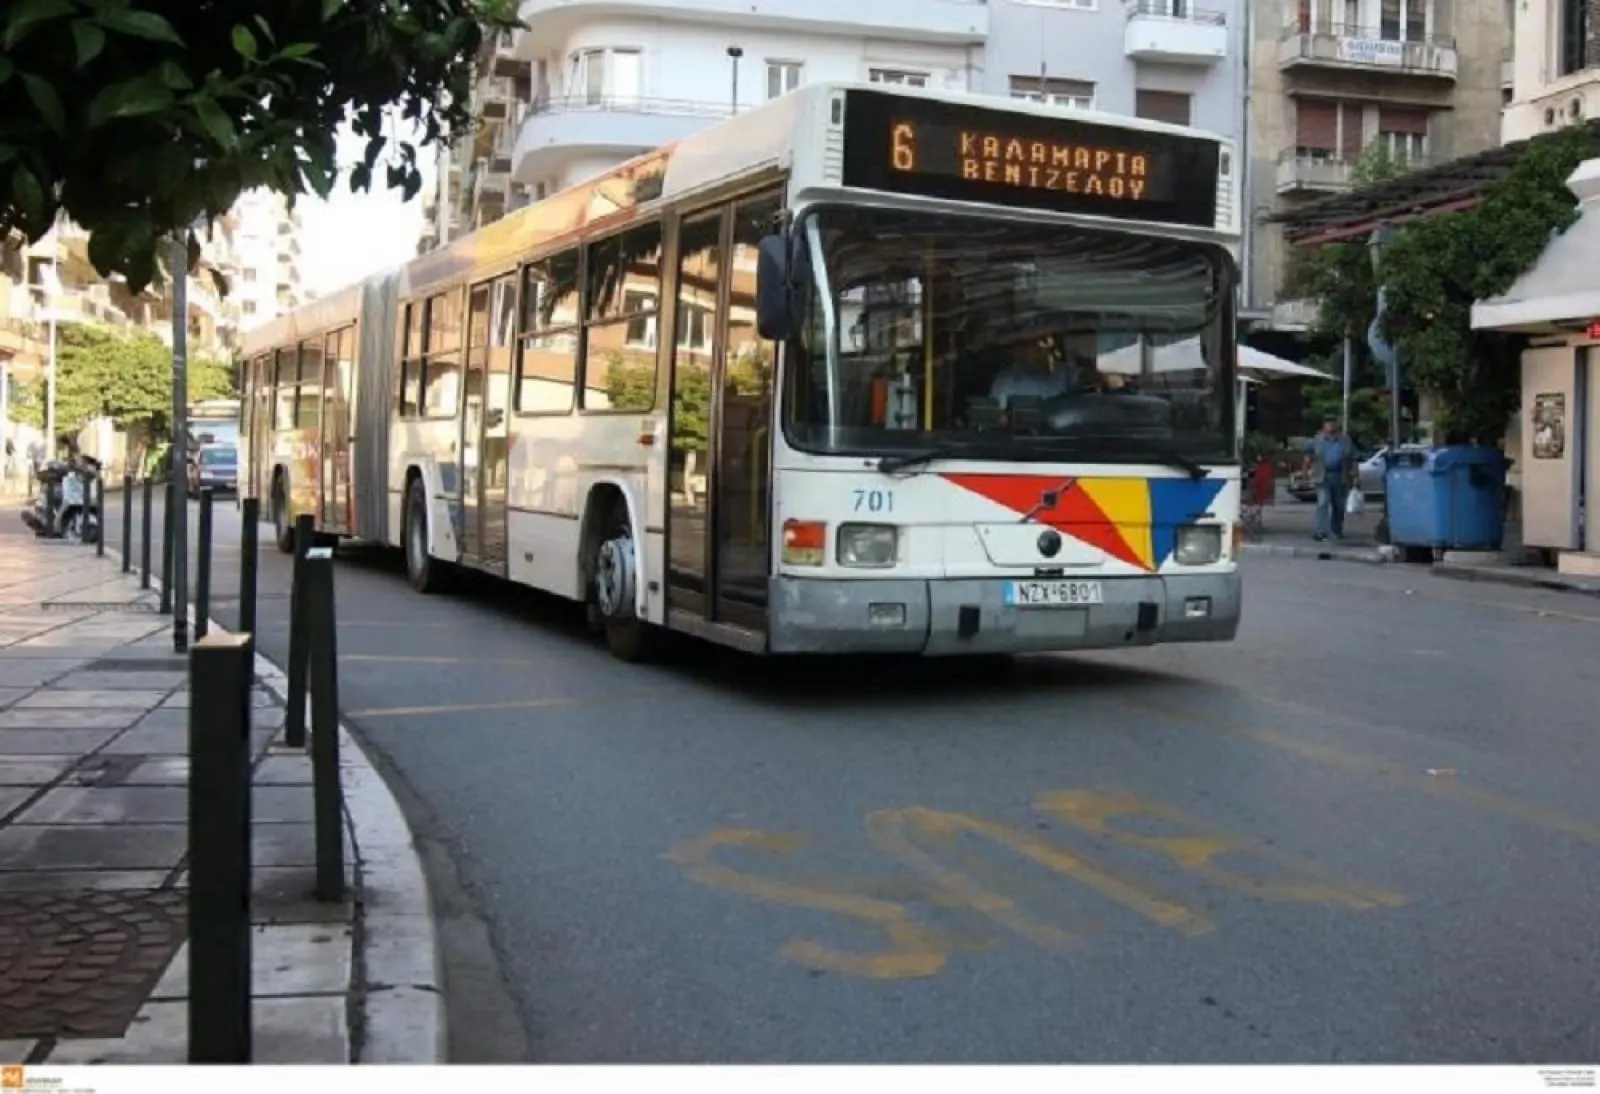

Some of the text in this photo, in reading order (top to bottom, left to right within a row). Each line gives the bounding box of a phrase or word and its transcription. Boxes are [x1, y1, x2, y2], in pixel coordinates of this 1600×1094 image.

[891, 123, 1147, 176] 6 ΚΑΛΑΜΑΡΙΑ
[962, 159, 1146, 199] ΒΕΝΙΖΕΛΟΥ
[852, 489, 894, 513] 701
